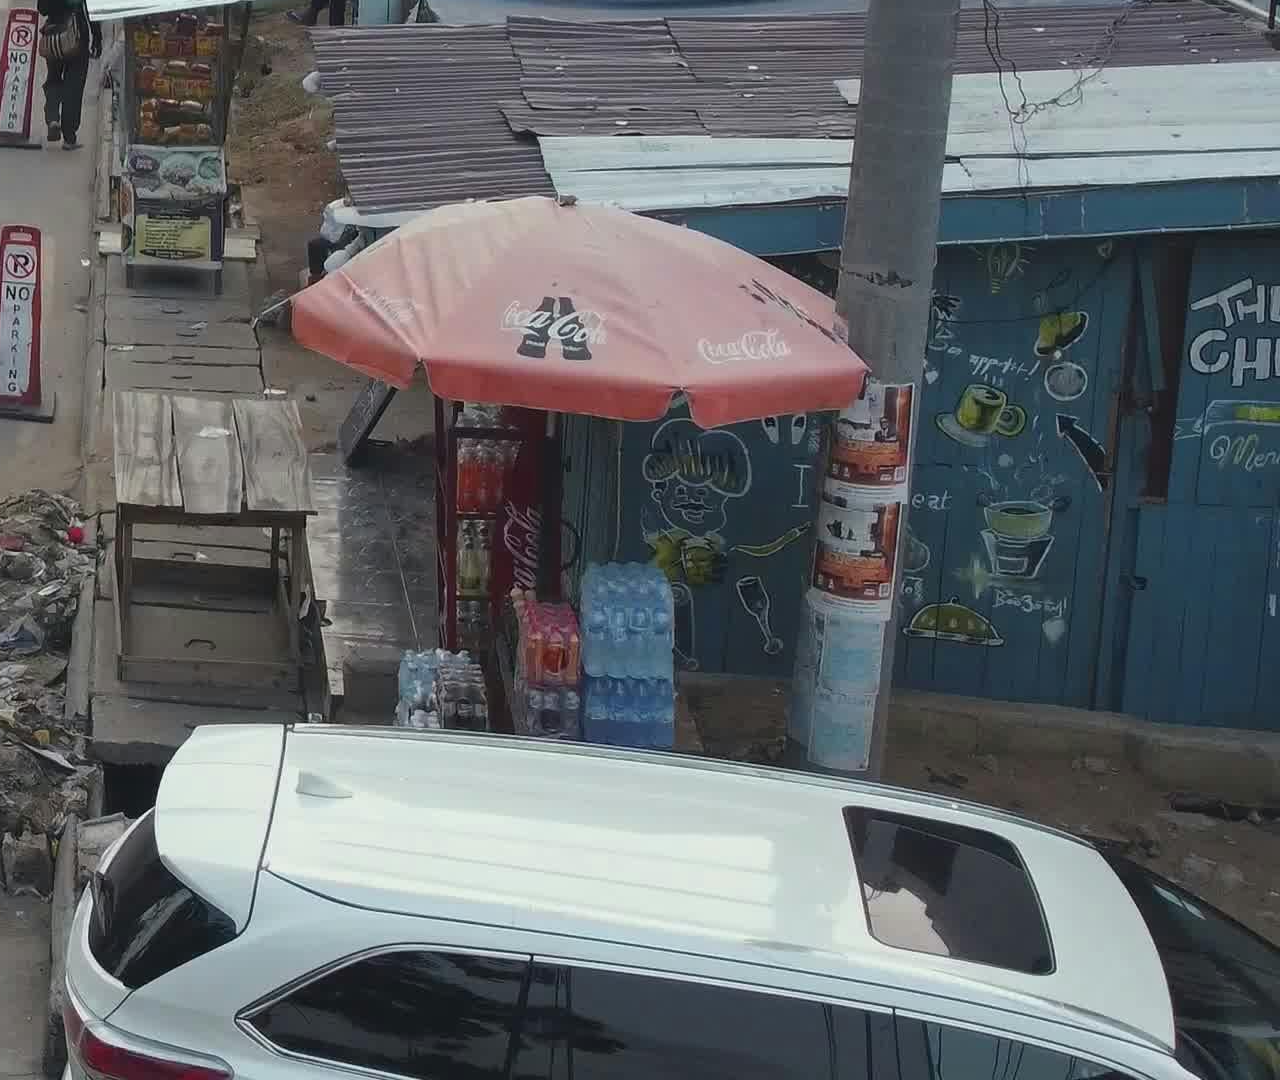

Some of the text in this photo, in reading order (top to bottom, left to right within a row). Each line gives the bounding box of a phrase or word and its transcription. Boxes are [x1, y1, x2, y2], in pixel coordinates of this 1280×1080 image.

[9, 52, 28, 65] NO
[5, 285, 30, 301] NO
[8, 304, 21, 393] PARKING
[1190, 328, 1280, 388] CH
[1210, 432, 1280, 472] Men
[912, 489, 953, 512] eat
